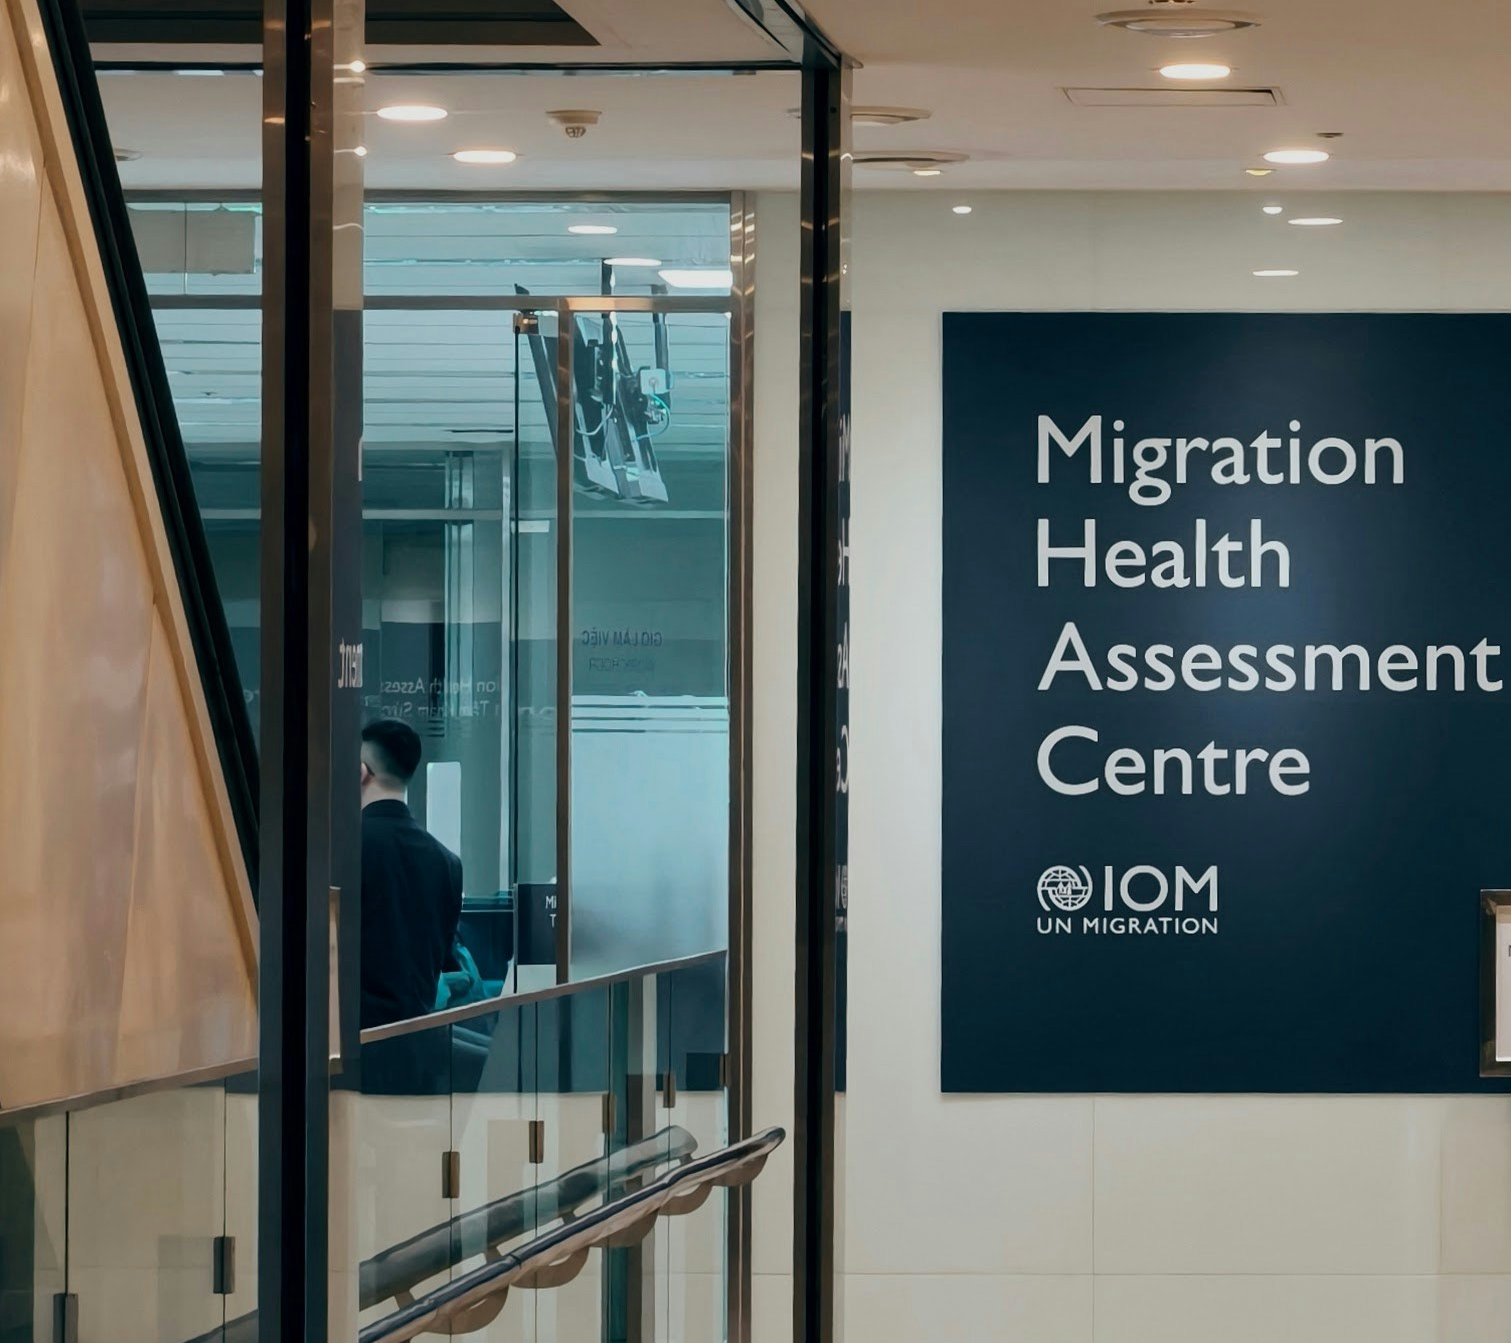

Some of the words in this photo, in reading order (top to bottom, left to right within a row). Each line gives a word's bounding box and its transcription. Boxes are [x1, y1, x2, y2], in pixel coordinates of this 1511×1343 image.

[1037, 414, 1404, 506] Migration
[1037, 518, 1291, 589] Health
[1037, 621, 1503, 692] Assessment
[1036, 725, 1311, 796] Centre
[1104, 864, 1218, 912] IOM
[1036, 917, 1072, 934] UN
[1083, 917, 1218, 935] MIGRATION
